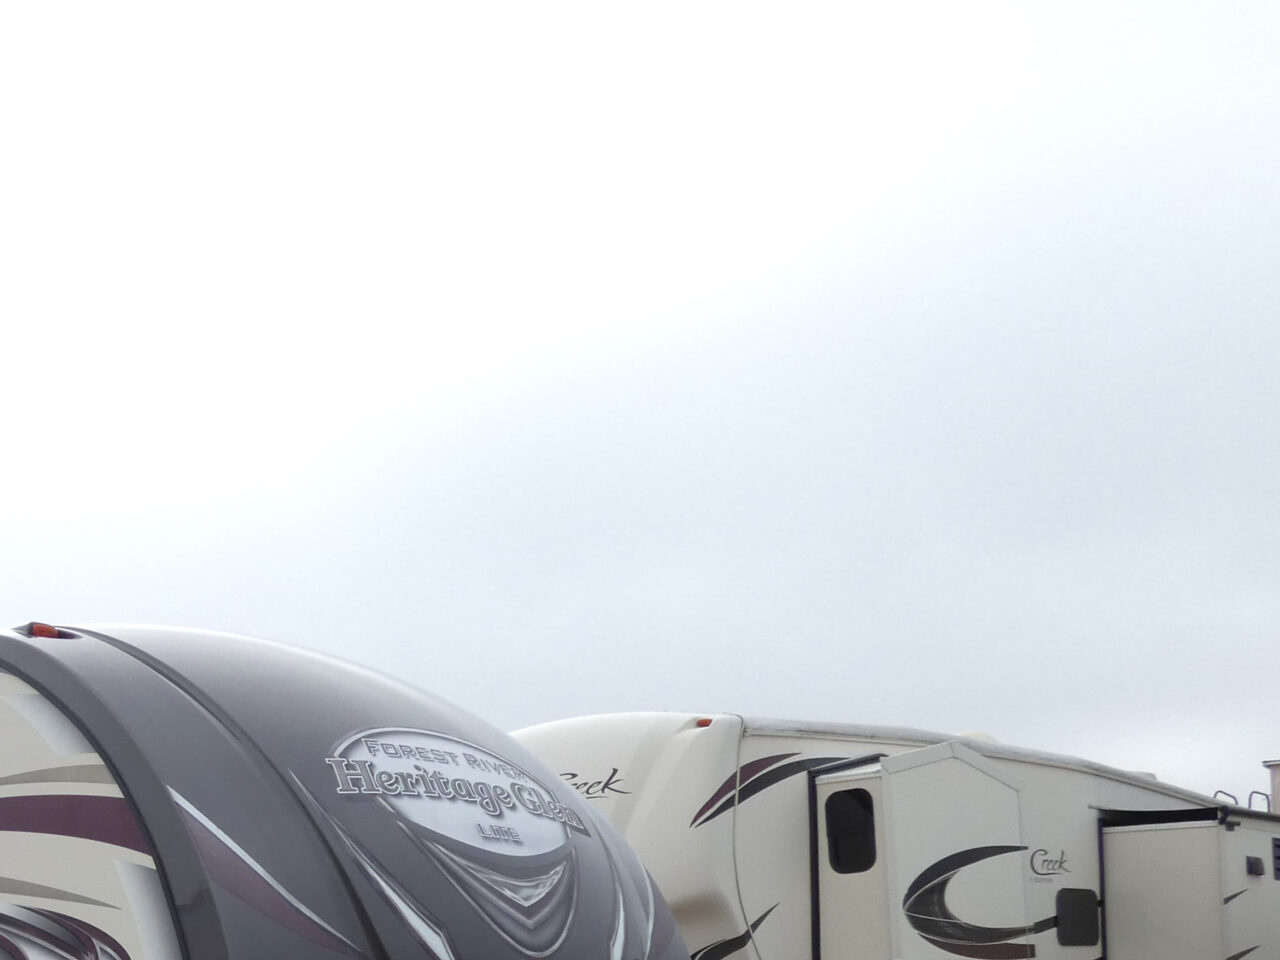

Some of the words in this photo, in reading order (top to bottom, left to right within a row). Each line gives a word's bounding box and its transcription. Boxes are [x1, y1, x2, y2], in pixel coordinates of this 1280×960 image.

[361, 738, 460, 767] FOREST
[461, 752, 525, 781] RIVER
[325, 757, 516, 817] Heritage
[509, 781, 586, 831] Glen
[560, 767, 632, 800] eek
[477, 823, 521, 843] LITE
[1030, 849, 1071, 876] Creek
